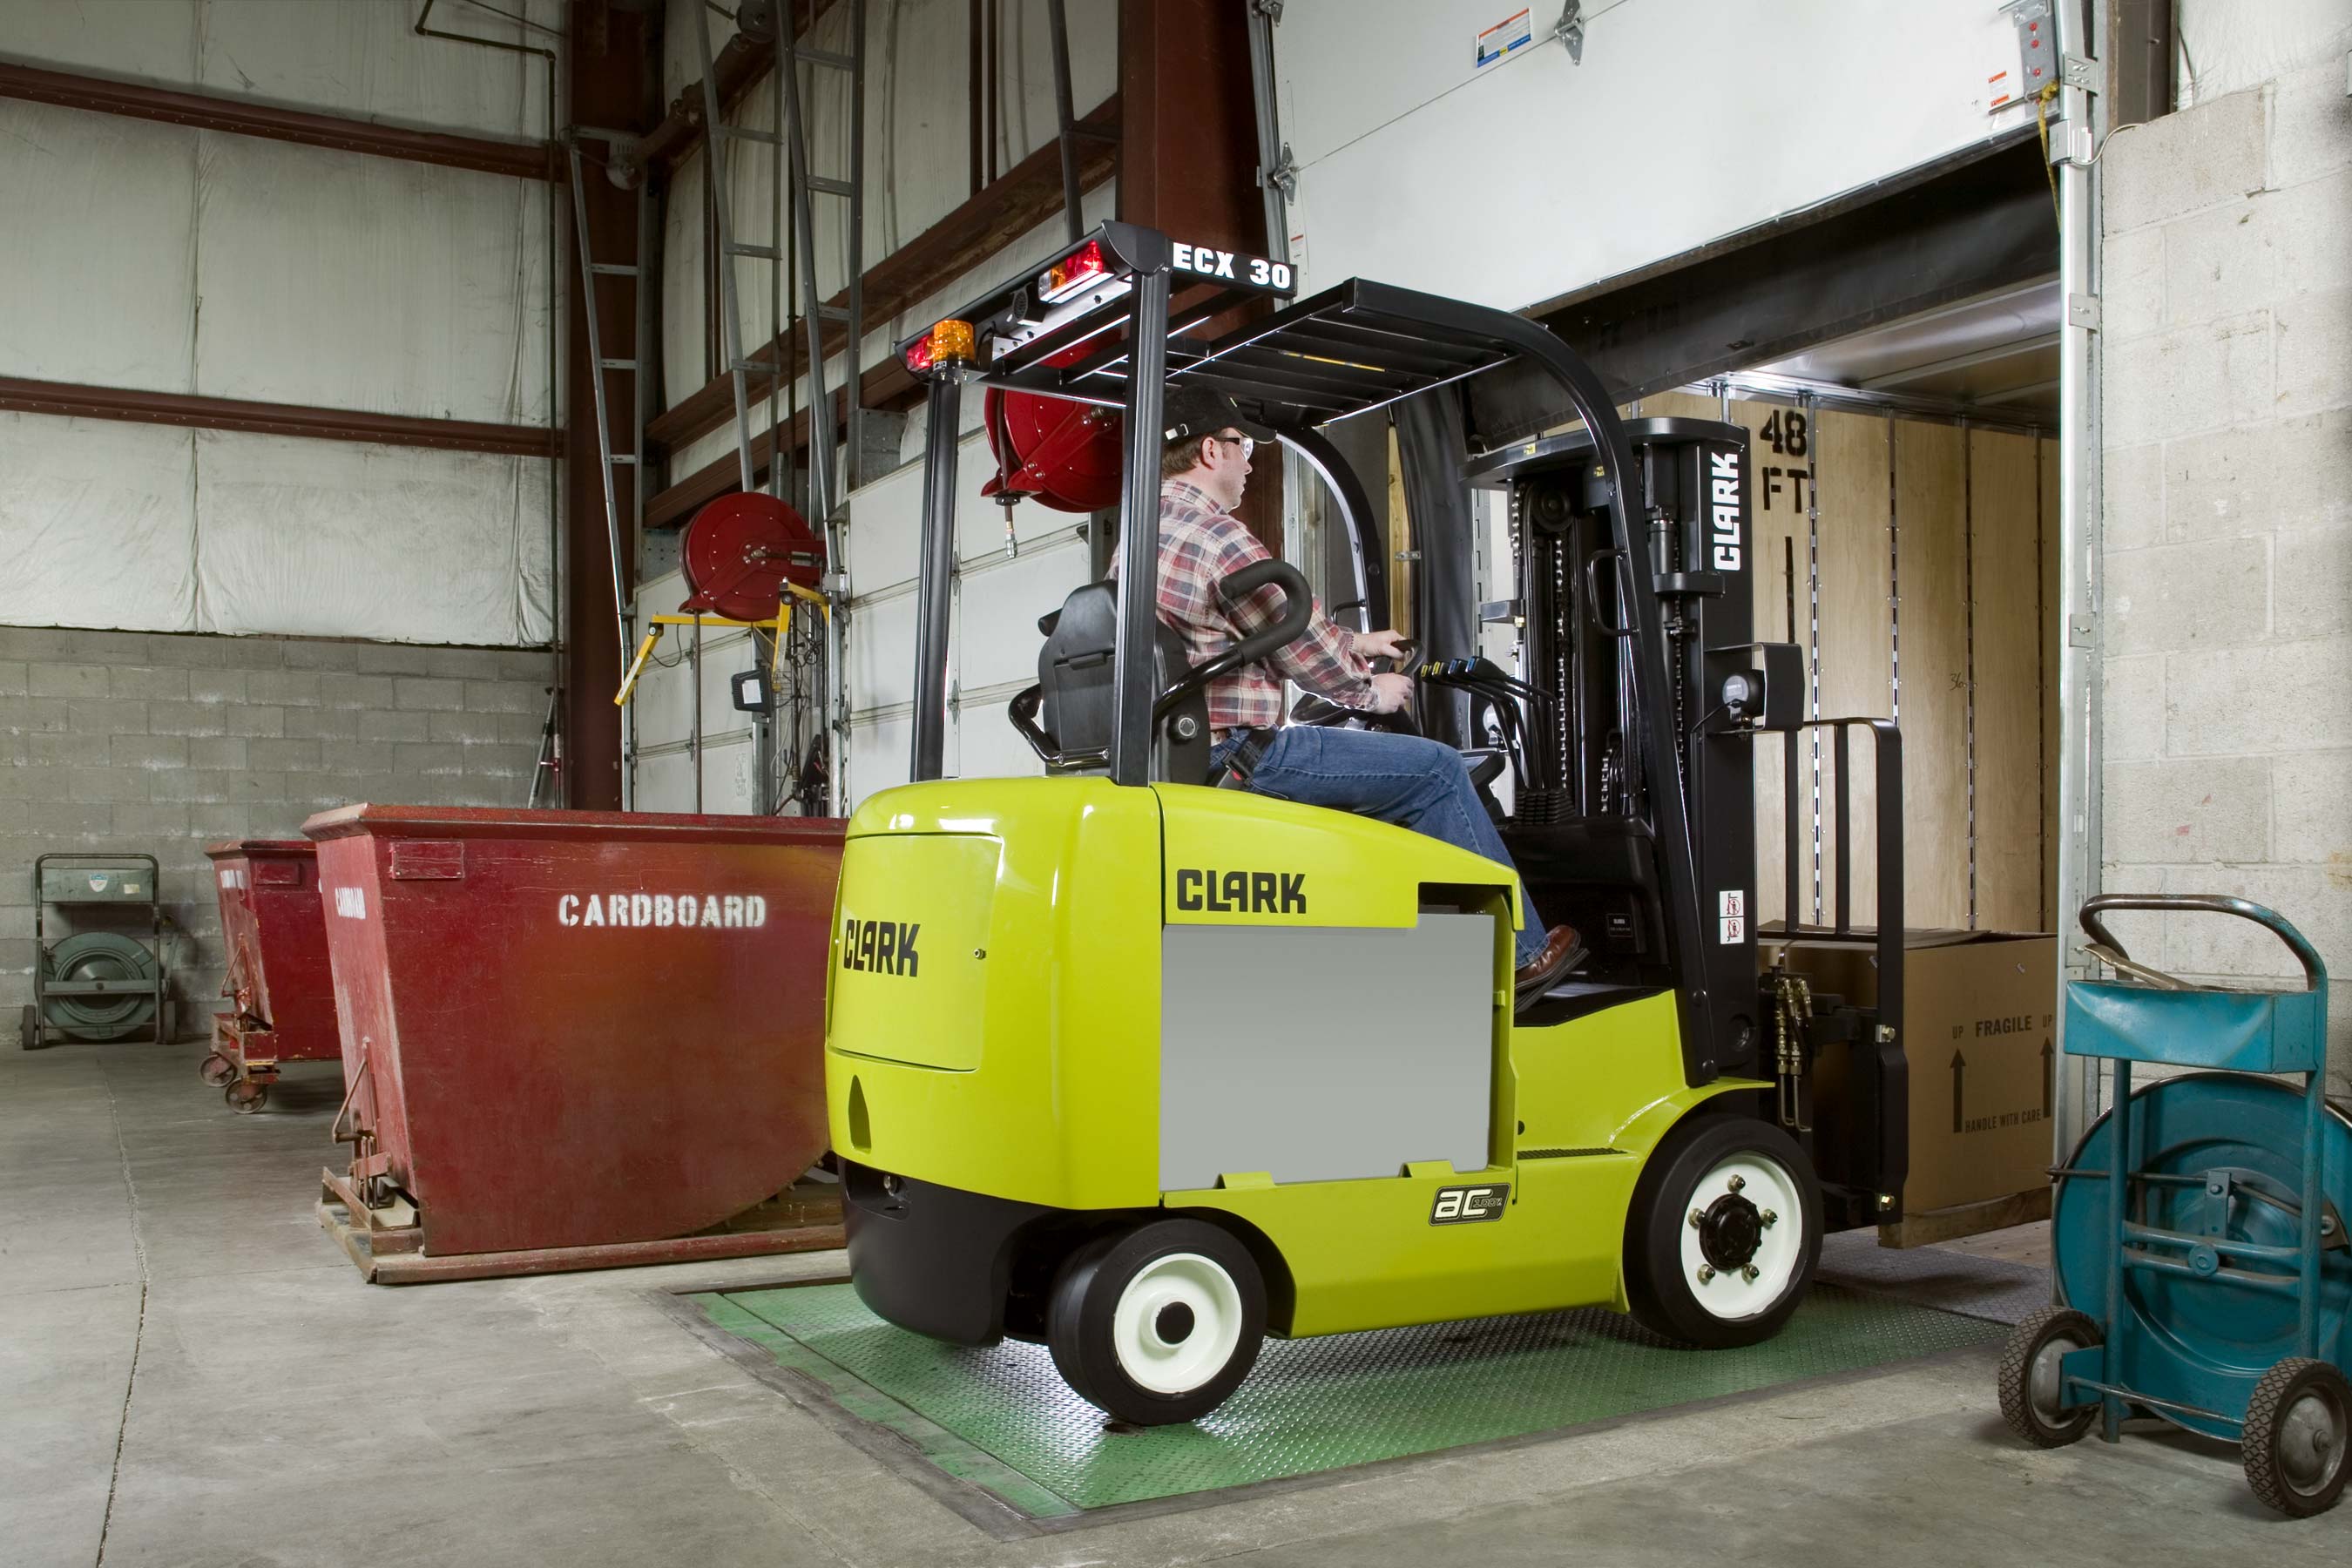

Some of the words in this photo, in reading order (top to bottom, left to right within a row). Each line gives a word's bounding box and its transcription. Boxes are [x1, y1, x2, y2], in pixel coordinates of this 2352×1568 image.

[1173, 242, 1235, 279] ECX
[1249, 259, 1291, 289] 30
[1759, 409, 1808, 456] 48
[1711, 451, 1741, 571] CLARK
[1761, 466, 1808, 514] FT
[558, 894, 767, 928] CARDBOARD
[1176, 868, 1307, 914] CLARK
[843, 919, 921, 977] CLARK
[1951, 1024, 1964, 1039] UP
[1975, 1015, 2032, 1037] FRAGILE
[2042, 1013, 2053, 1028] UP
[1965, 1116, 1997, 1133] HANDLE
[1998, 1111, 2019, 1128] WITH
[2021, 1108, 2042, 1125] CARE
